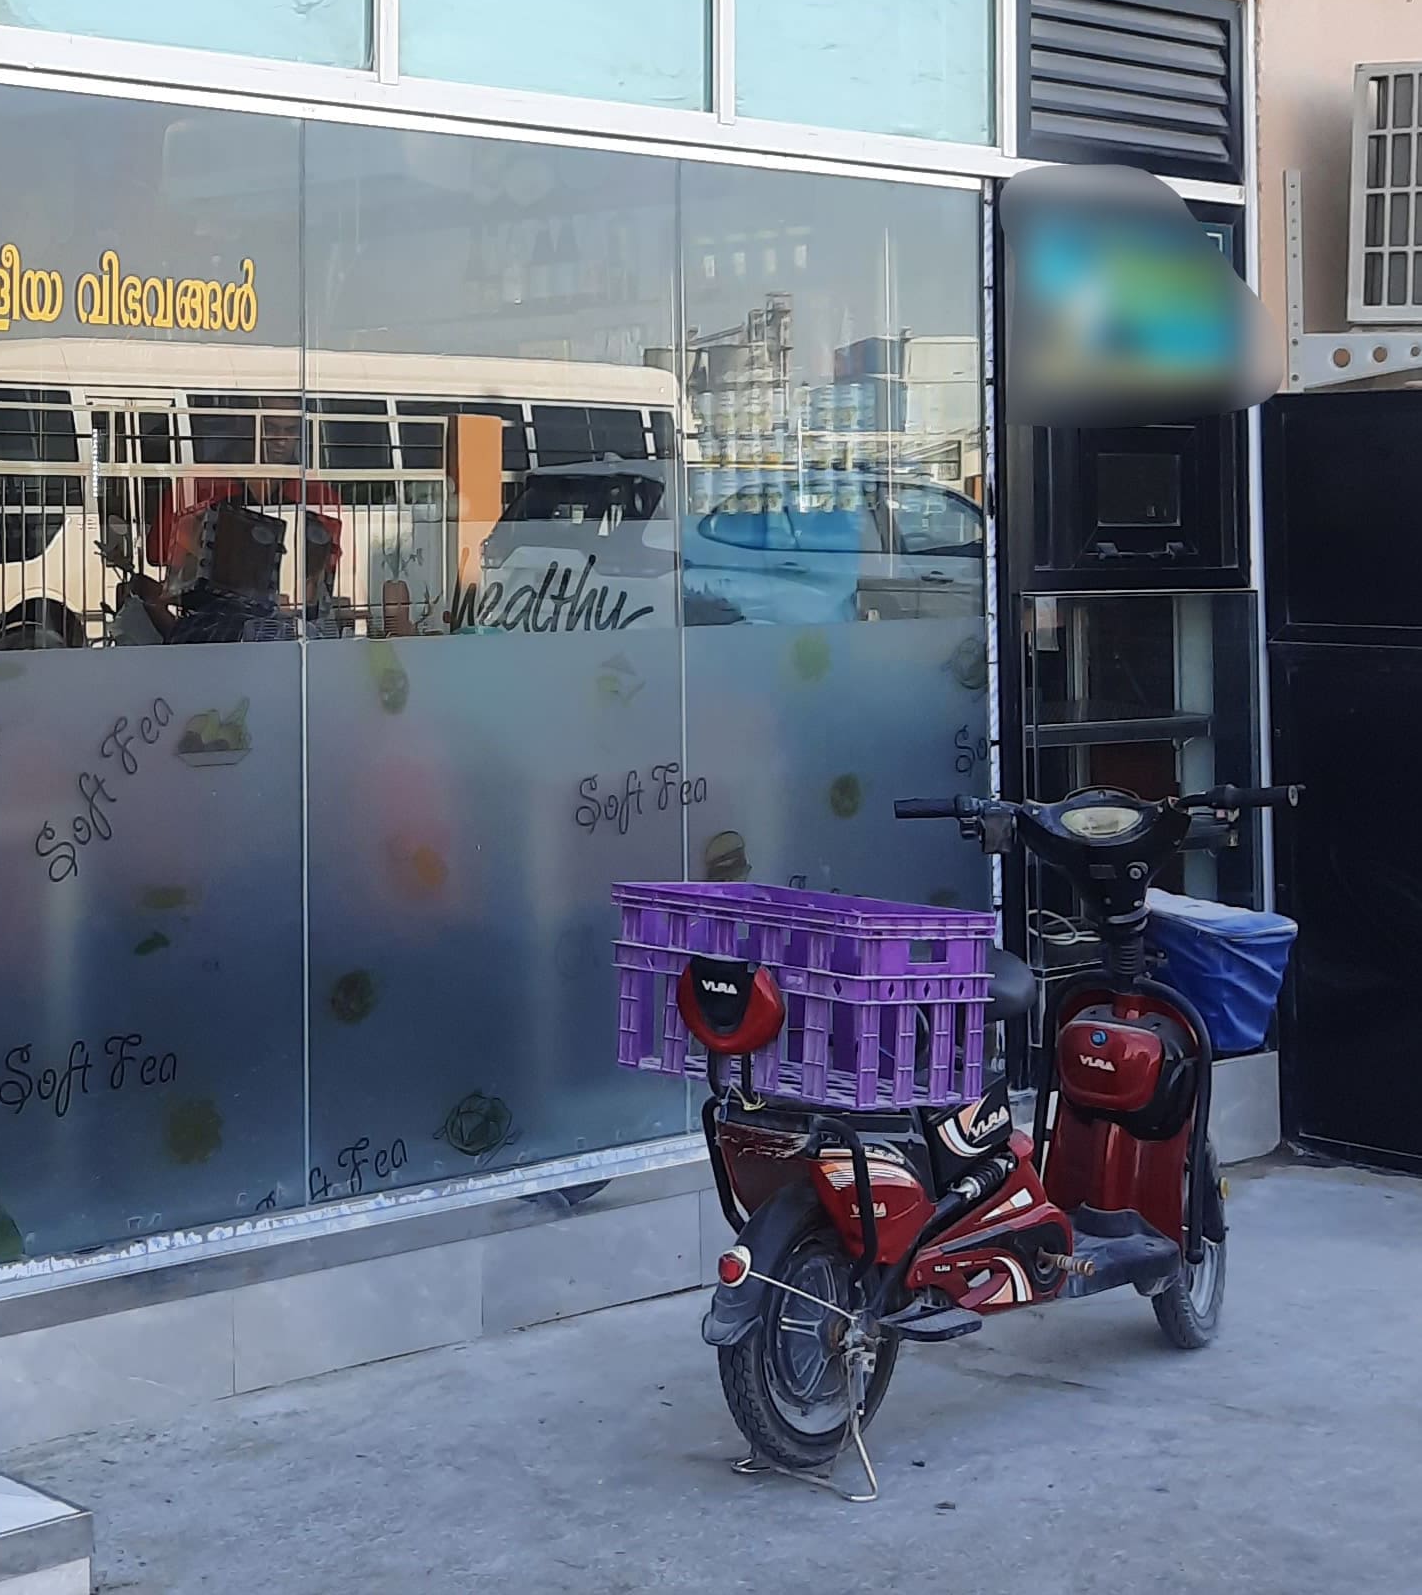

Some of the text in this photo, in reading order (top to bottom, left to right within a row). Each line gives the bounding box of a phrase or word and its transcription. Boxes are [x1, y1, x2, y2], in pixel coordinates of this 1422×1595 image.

[76, 250, 258, 333] വിഭവങ്ങൾ
[35, 771, 118, 883] Soft
[575, 770, 645, 836] Soft
